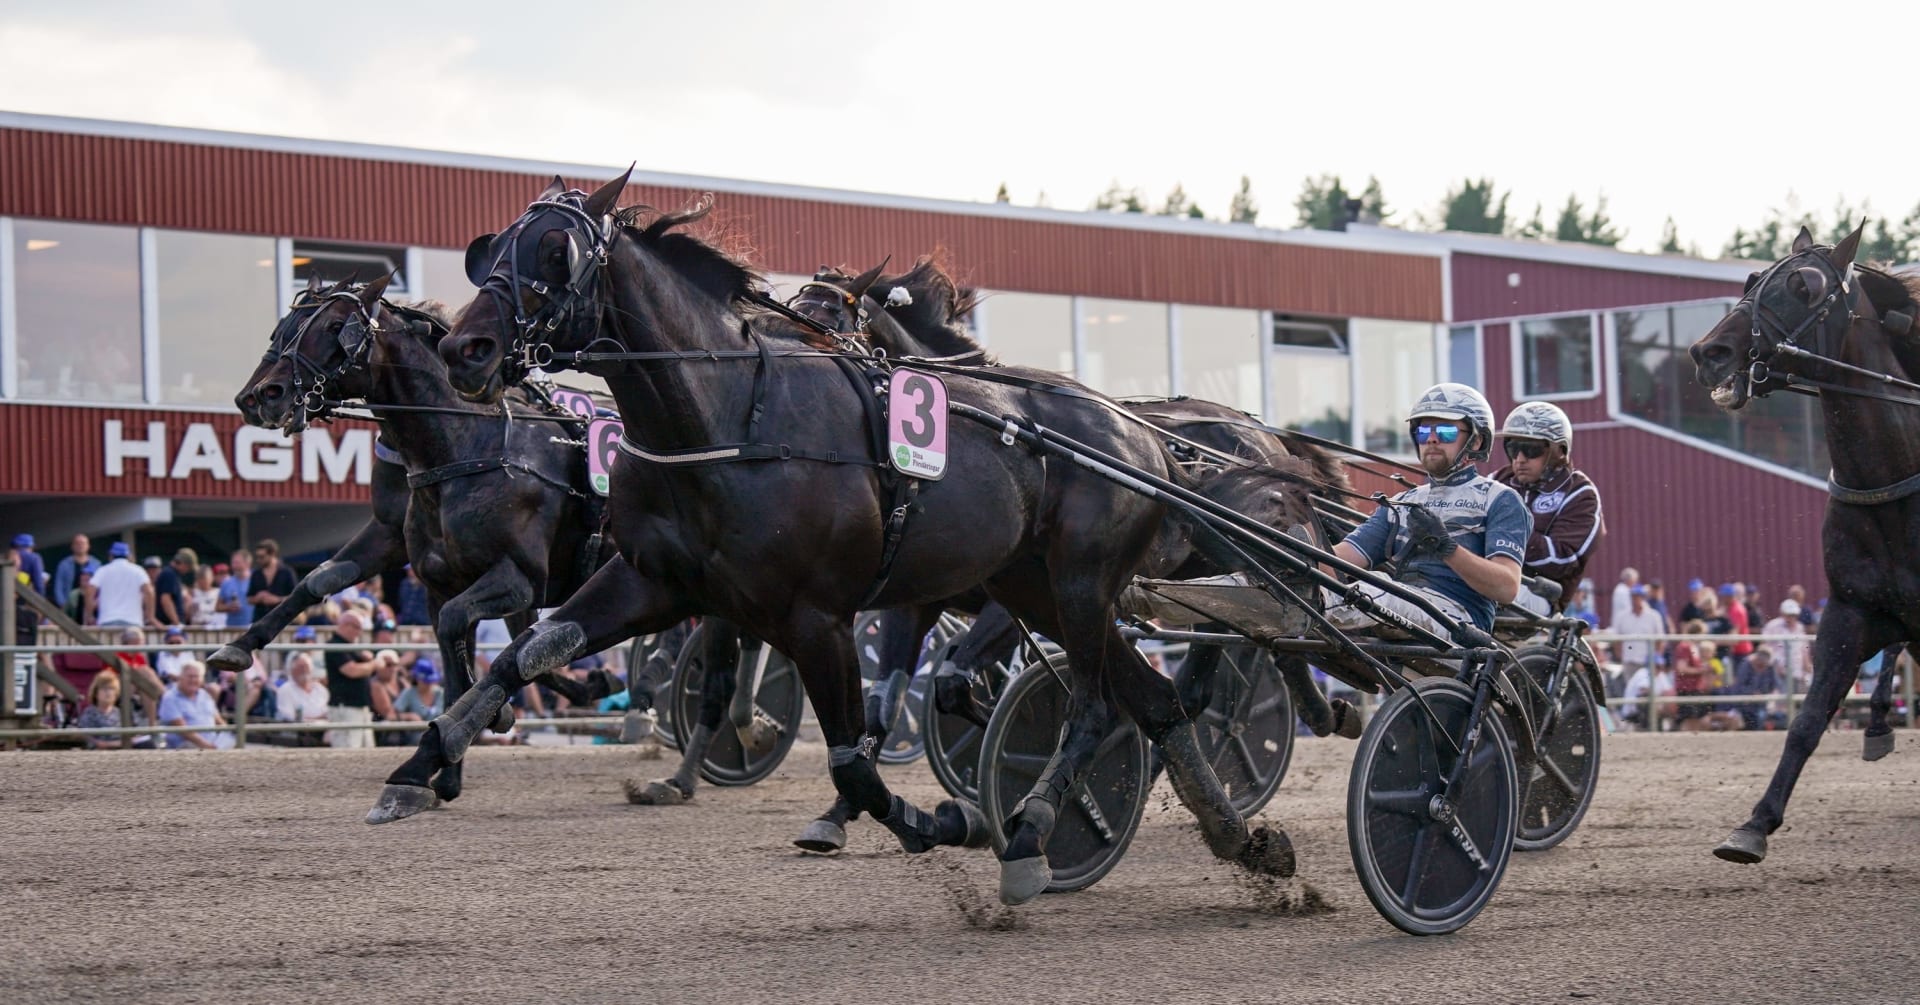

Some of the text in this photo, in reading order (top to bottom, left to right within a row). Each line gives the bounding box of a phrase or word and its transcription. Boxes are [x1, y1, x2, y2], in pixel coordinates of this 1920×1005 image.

[901, 375, 936, 448] 3
[104, 419, 371, 485] HAGM
[598, 423, 624, 473] 6
[1455, 499, 1487, 511] Global
